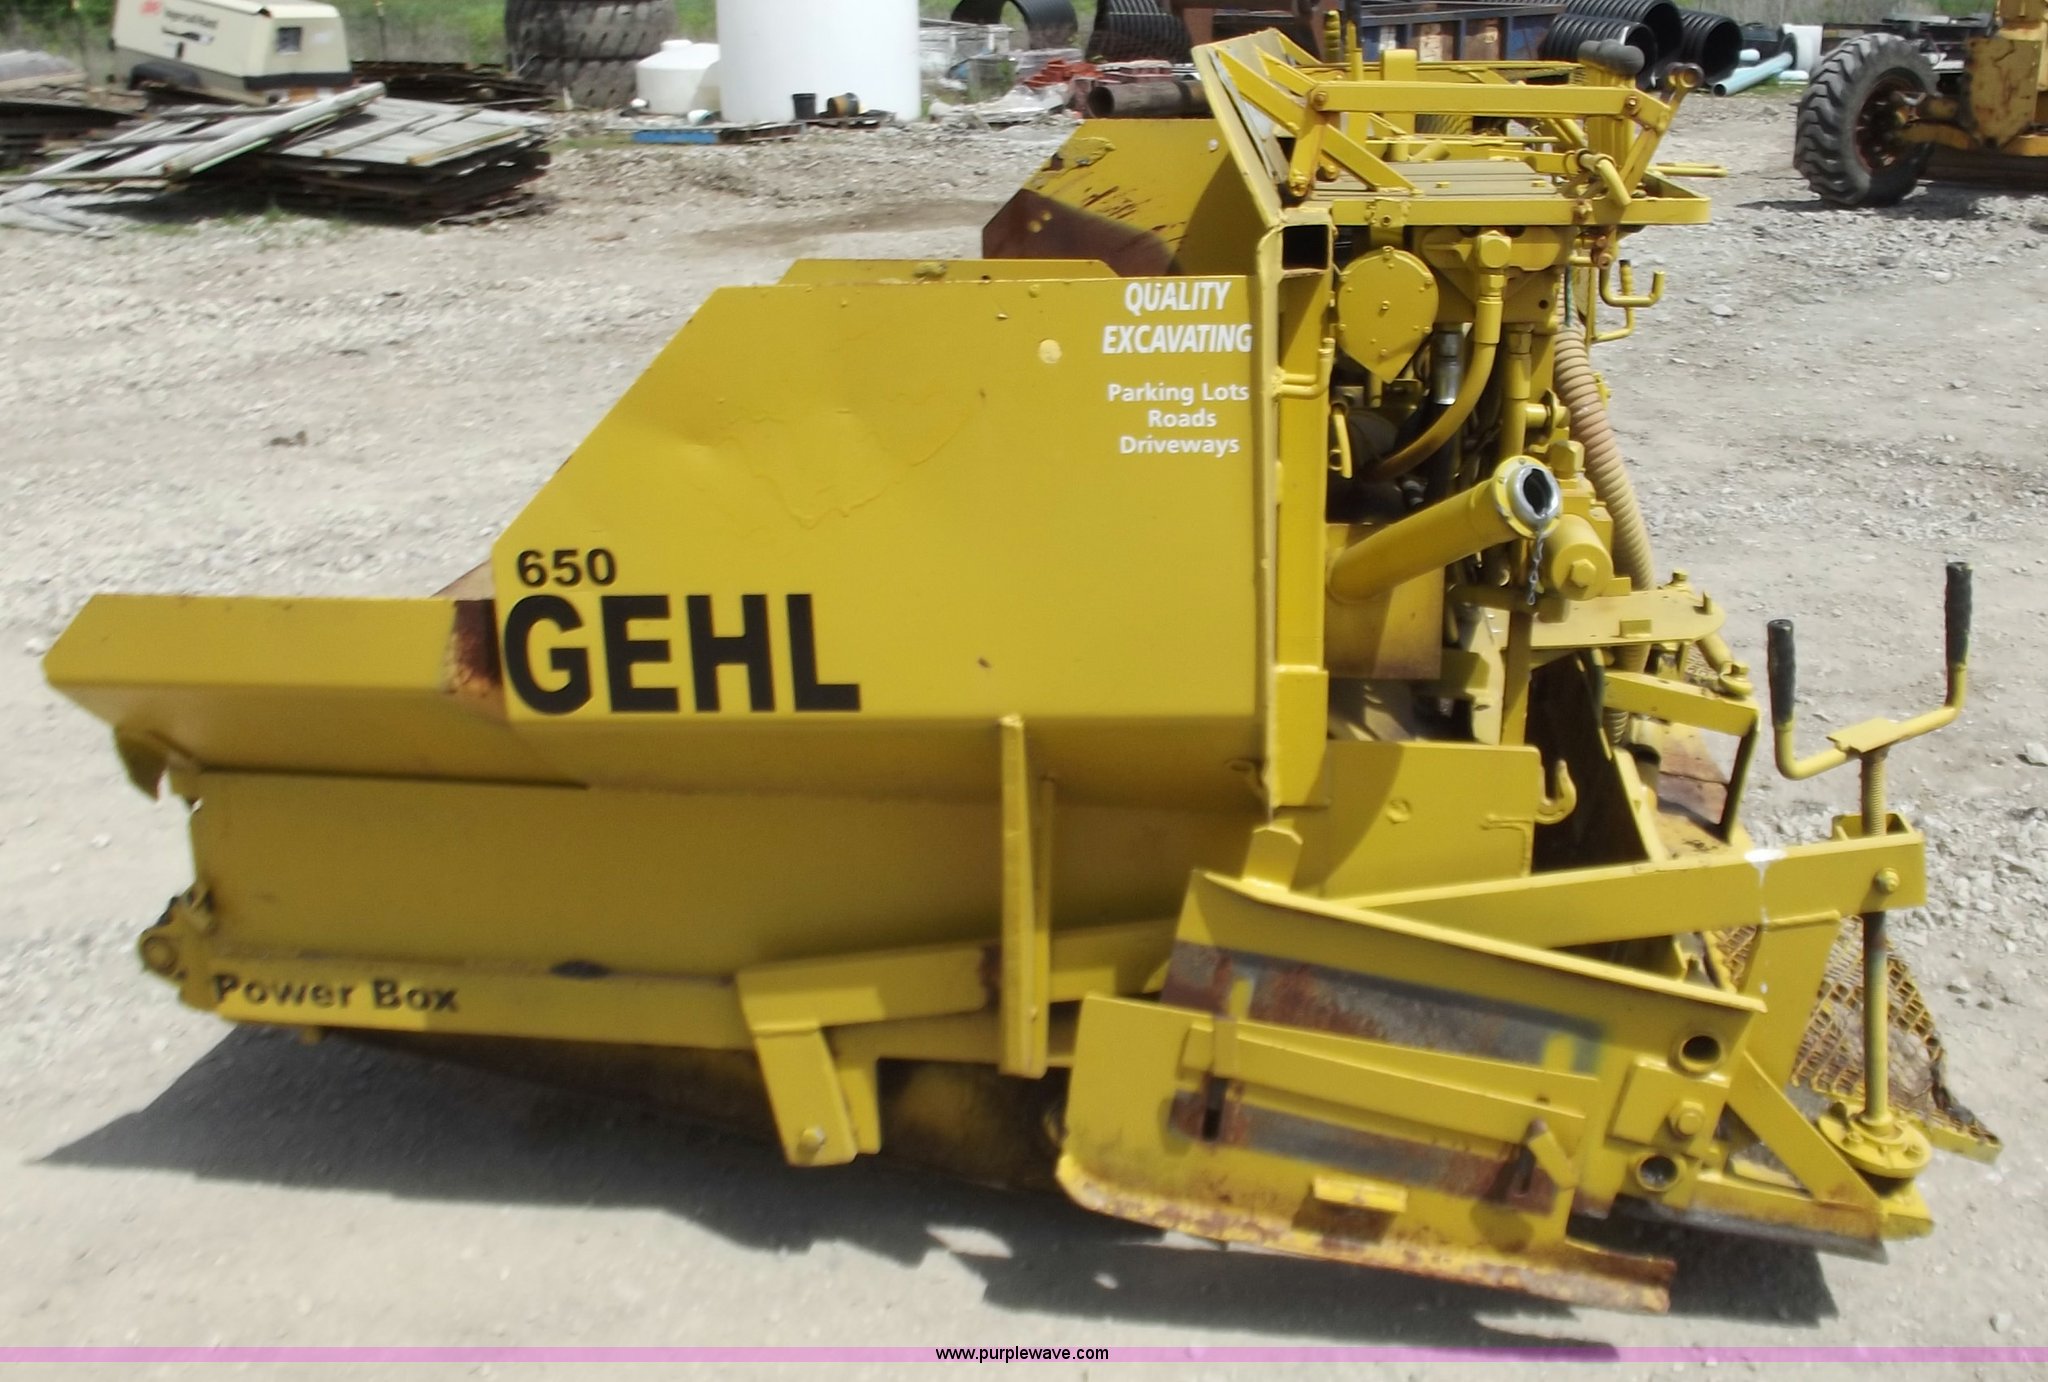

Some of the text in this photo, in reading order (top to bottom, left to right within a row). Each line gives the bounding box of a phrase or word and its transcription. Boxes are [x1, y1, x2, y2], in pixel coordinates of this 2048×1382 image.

[1124, 282, 1231, 316] QUALITY
[1102, 324, 1253, 354] EXCAVATING
[1107, 382, 1250, 406] Parking Lots
[1148, 408, 1217, 428] Roads
[1119, 435, 1241, 458] Driveways
[516, 548, 617, 588] 650
[504, 593, 861, 716] GEHL
[213, 972, 459, 1013] Power Box
